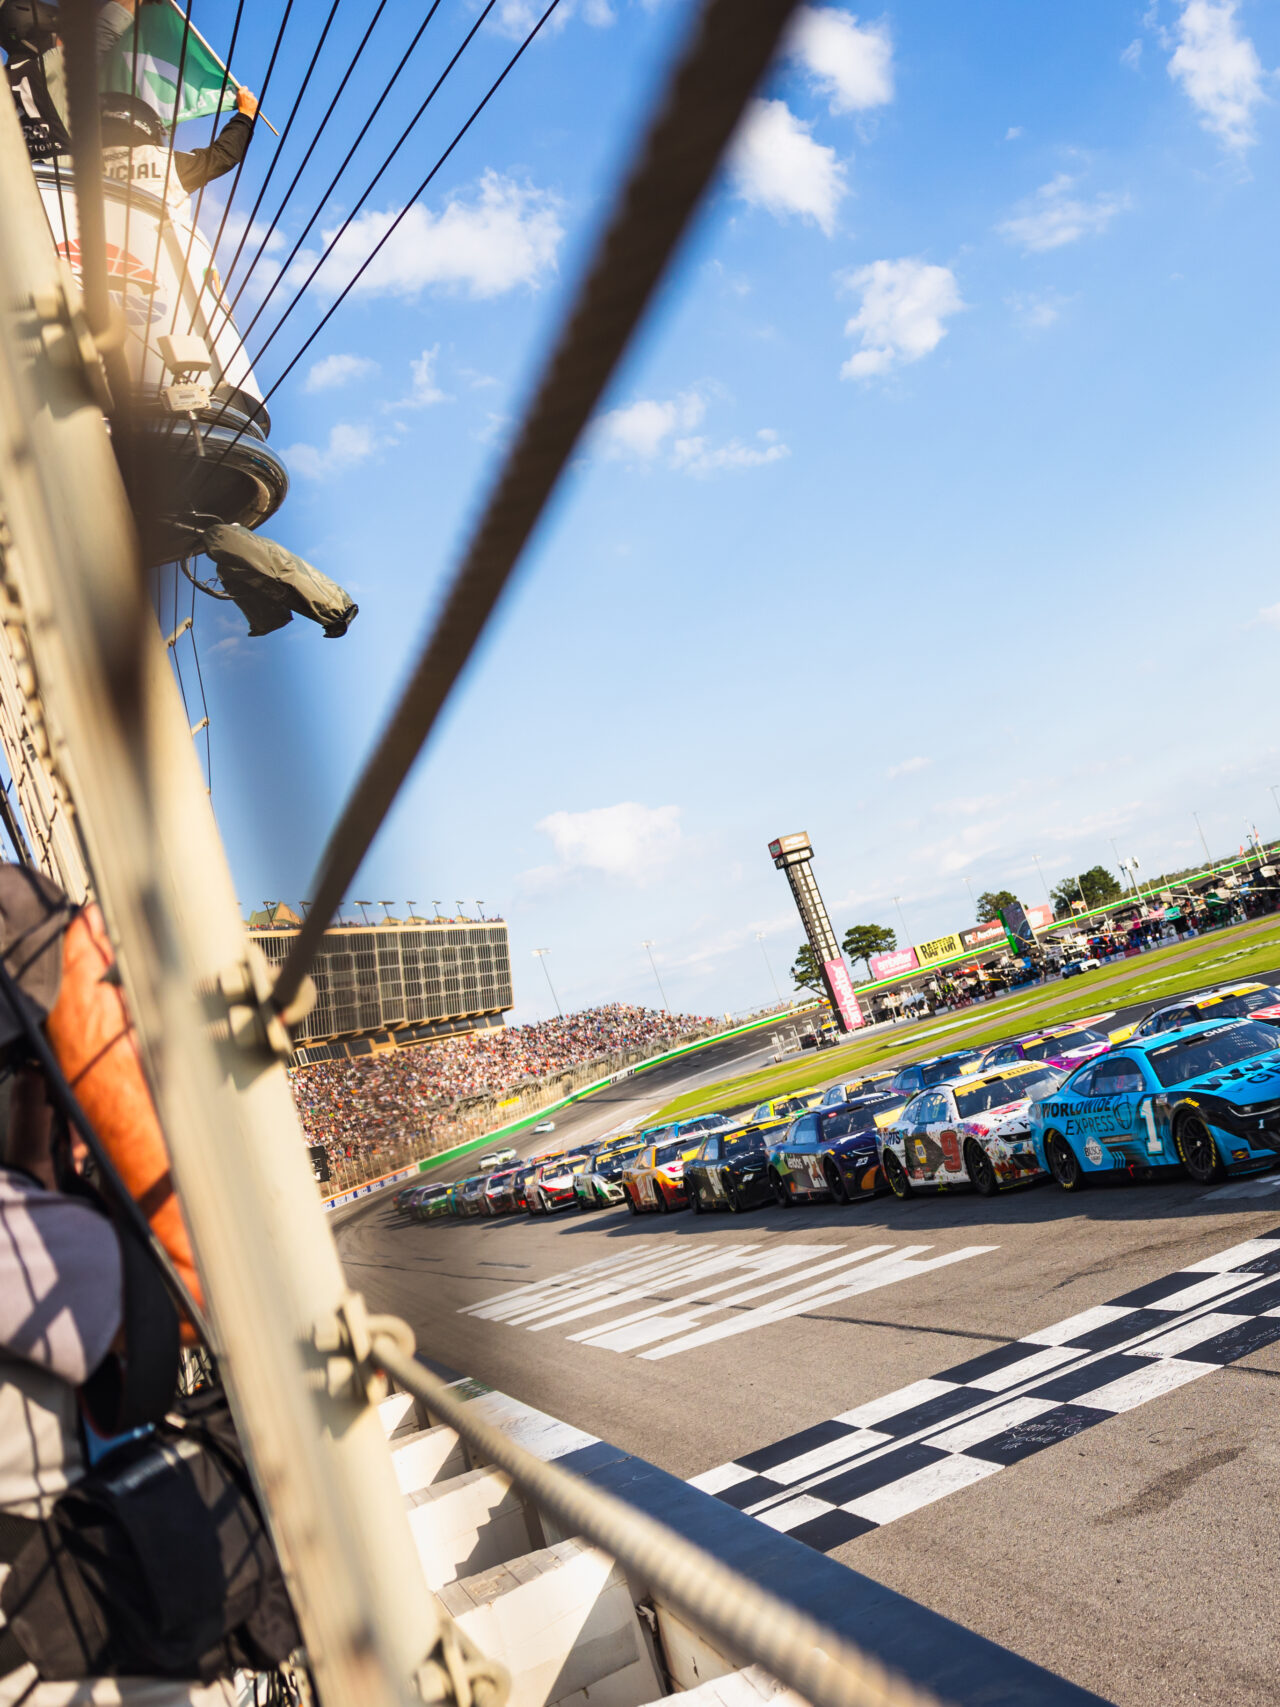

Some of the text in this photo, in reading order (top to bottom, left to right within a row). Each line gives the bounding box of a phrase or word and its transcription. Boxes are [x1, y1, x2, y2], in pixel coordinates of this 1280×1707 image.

[920, 937, 956, 960] RAPTOR
[1042, 1097, 1114, 1119] WORLDWIDE
[1065, 1115, 1115, 1136] EXPRESS
[1139, 1098, 1164, 1154] 1
[1257, 1118, 1265, 1129] 1
[855, 1156, 868, 1167] 23
[940, 1130, 962, 1173] 9
